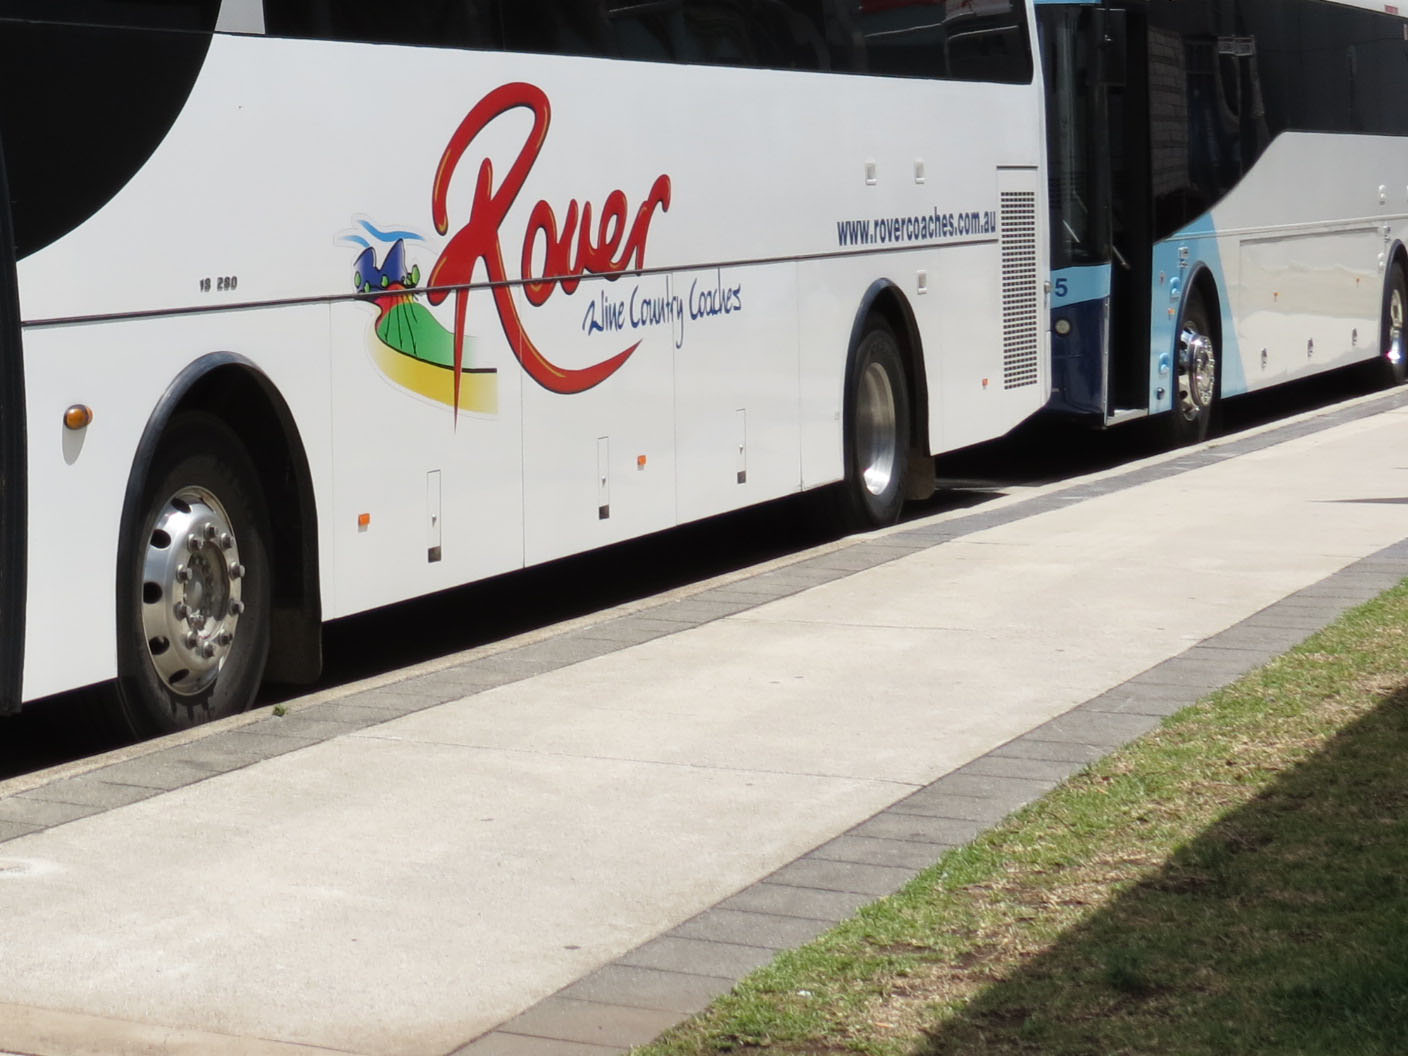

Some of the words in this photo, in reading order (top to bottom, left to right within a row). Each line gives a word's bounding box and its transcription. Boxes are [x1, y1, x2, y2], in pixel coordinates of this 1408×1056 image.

[837, 206, 996, 246] www.rovercoaches.com.au
[427, 81, 672, 434] Rover
[1055, 277, 1068, 297] 5
[582, 289, 626, 336] Wine
[629, 274, 685, 349] Country
[688, 265, 742, 321] Coaches
